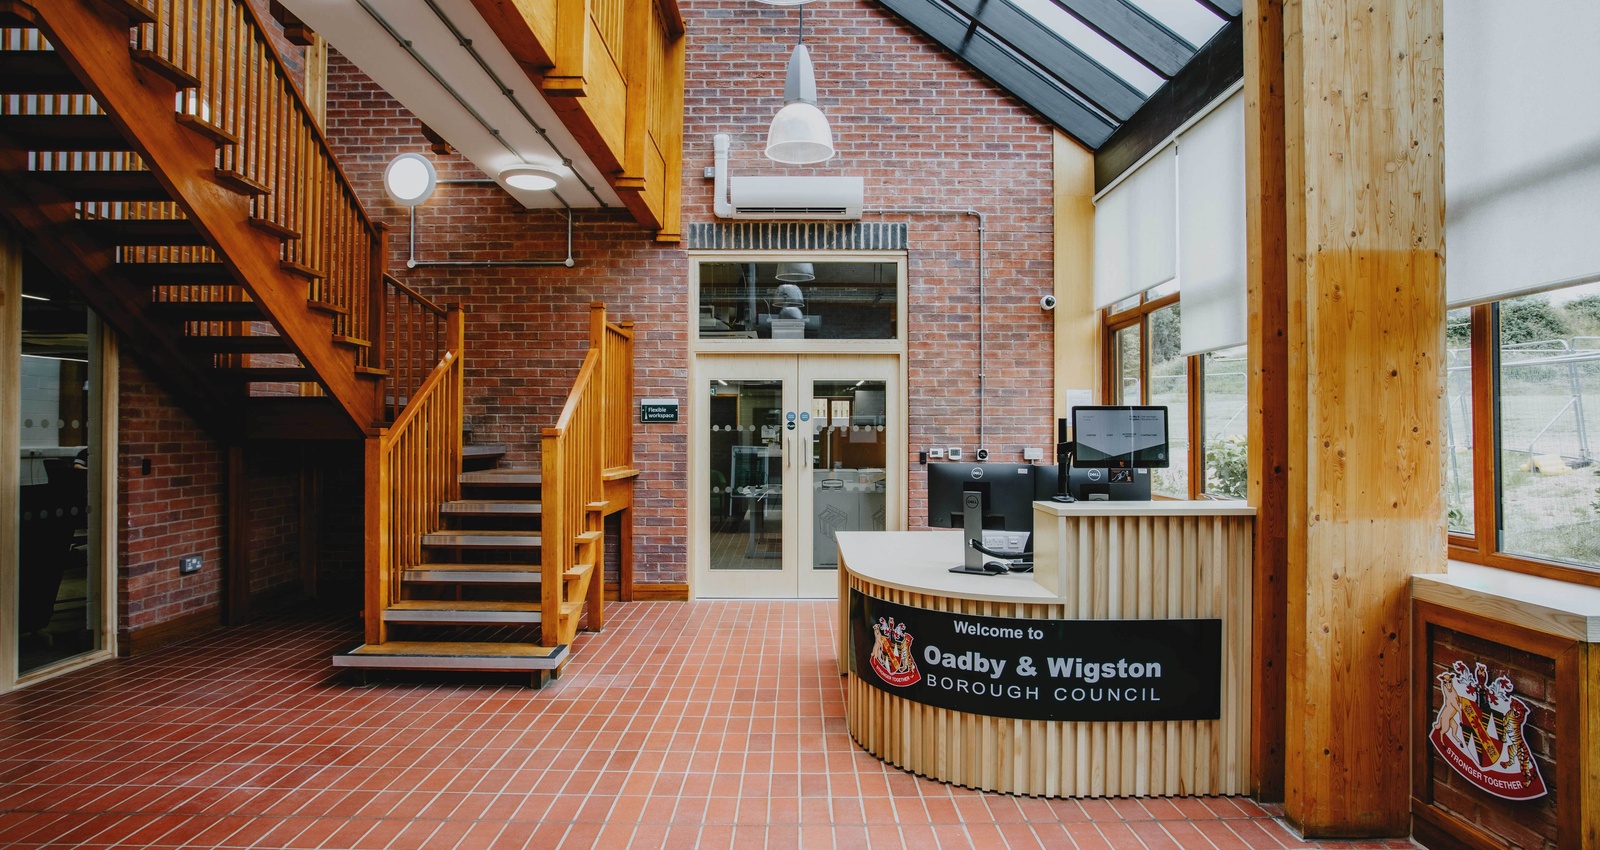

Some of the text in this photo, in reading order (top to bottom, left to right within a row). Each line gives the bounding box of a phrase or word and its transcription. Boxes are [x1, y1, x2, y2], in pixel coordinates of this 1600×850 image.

[953, 620, 1044, 640] Welcome to
[923, 645, 1162, 684] Oadby & Wigston
[926, 673, 1161, 702] BOROUGH COUNCIL
[1446, 747, 1523, 790] STRONGER TOGETHER
